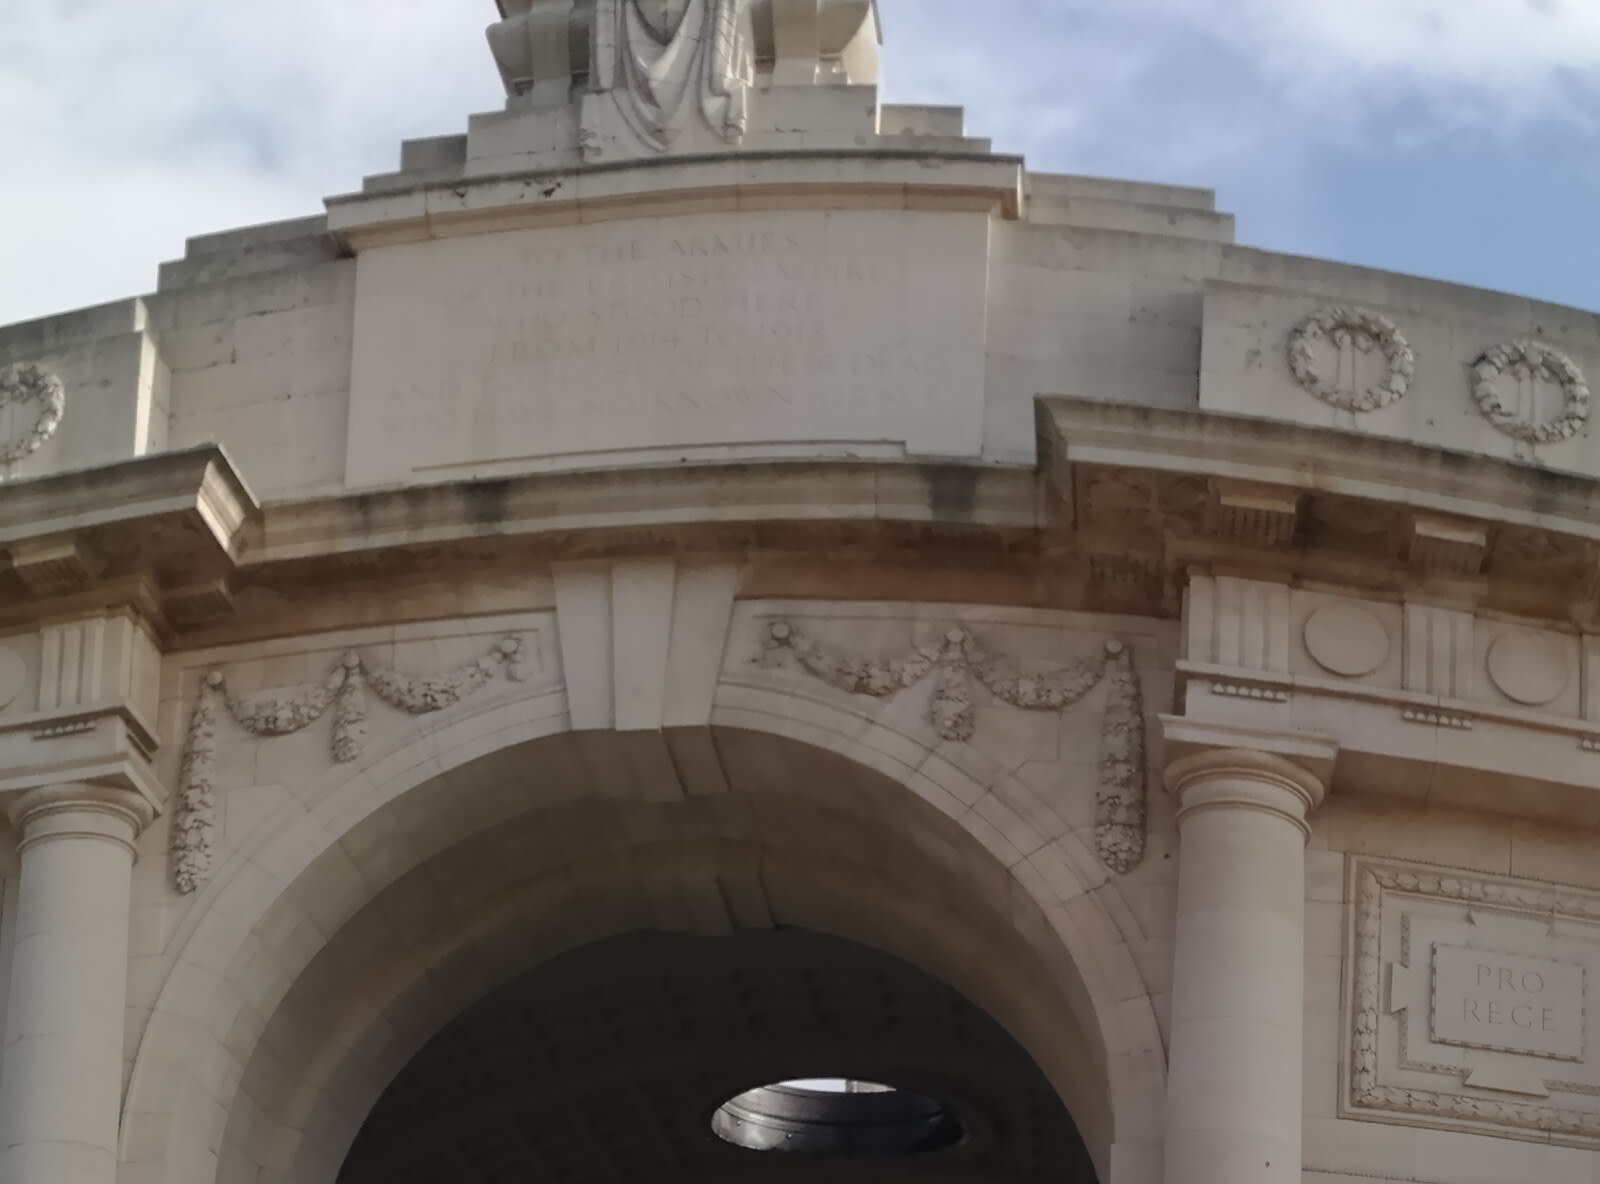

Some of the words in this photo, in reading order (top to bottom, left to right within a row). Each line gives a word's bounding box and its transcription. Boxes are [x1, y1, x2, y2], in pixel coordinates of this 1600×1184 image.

[579, 241, 646, 264] THE
[667, 231, 801, 257] ARMIES
[504, 278, 564, 301] THE
[586, 294, 703, 325] STOOD
[490, 334, 597, 364] FROM
[734, 351, 837, 376] THEIR
[654, 385, 794, 413] KNOWN
[1475, 963, 1546, 994] PRO
[1462, 997, 1557, 1033] REGE
